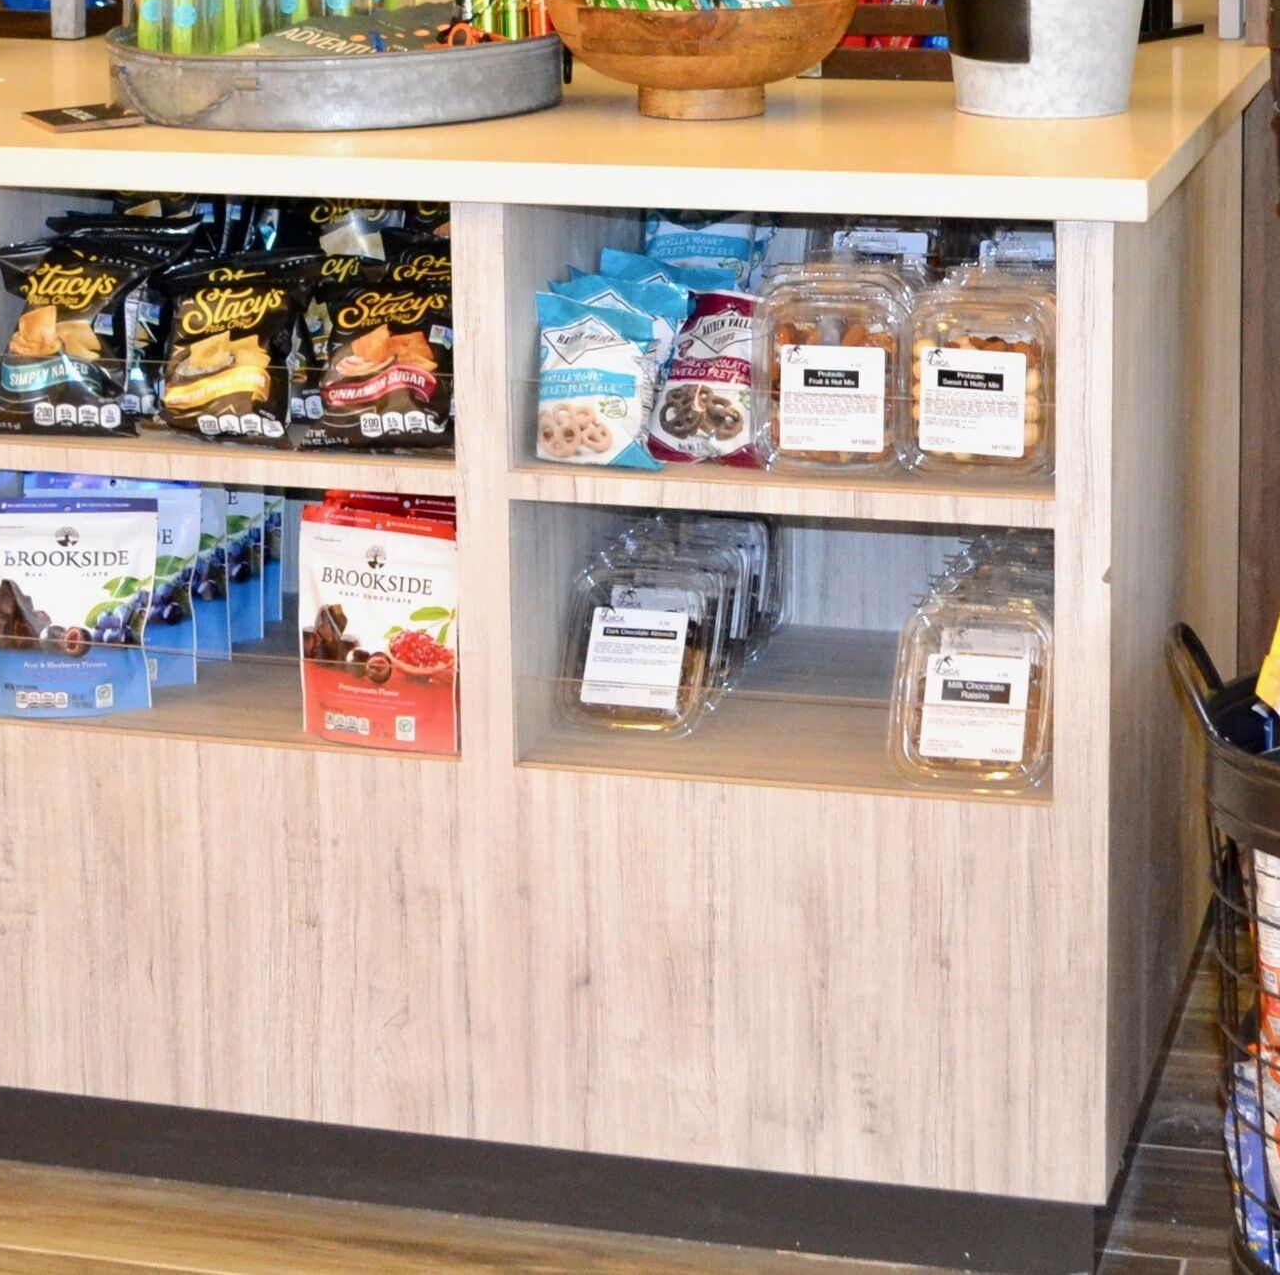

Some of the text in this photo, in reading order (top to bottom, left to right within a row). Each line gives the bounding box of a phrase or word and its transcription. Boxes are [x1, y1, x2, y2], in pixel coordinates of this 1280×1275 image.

[183, 287, 285, 335] Stacy's
[338, 291, 448, 330] Stacy's
[728, 317, 752, 330] VALL
[9, 363, 89, 386] SIMPLY NAED
[329, 370, 426, 400] CINNAMON SUGAR
[36, 407, 52, 418] 200
[363, 417, 380, 429] 200
[4, 550, 129, 569] BROOKSIDE
[321, 566, 433, 596] BROOKSIDE
[961, 690, 990, 701] Raisins
